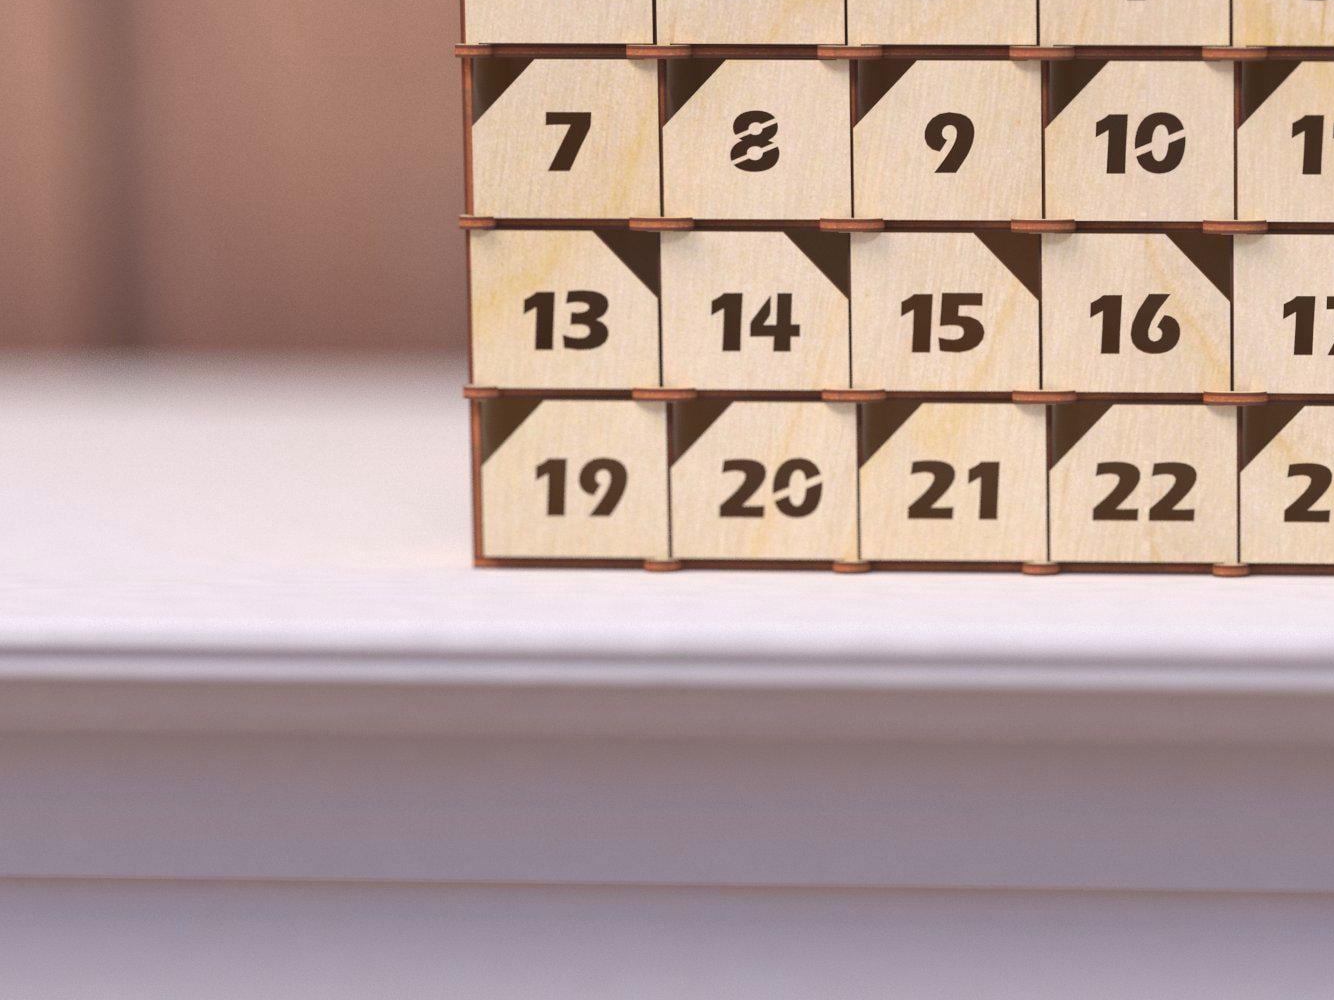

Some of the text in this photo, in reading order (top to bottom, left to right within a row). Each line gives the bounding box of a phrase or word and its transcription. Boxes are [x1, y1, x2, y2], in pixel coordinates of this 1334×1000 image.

[546, 112, 591, 171] 7
[730, 111, 779, 172] 8
[925, 112, 974, 173] 9
[1096, 112, 1185, 174] 10
[524, 291, 608, 350] 13
[711, 293, 800, 351] 14
[901, 293, 984, 352] 15
[1090, 294, 1180, 354] 16
[536, 458, 627, 516] 19
[720, 458, 822, 517] 20
[908, 461, 999, 519] 21
[1093, 462, 1197, 521] 22
